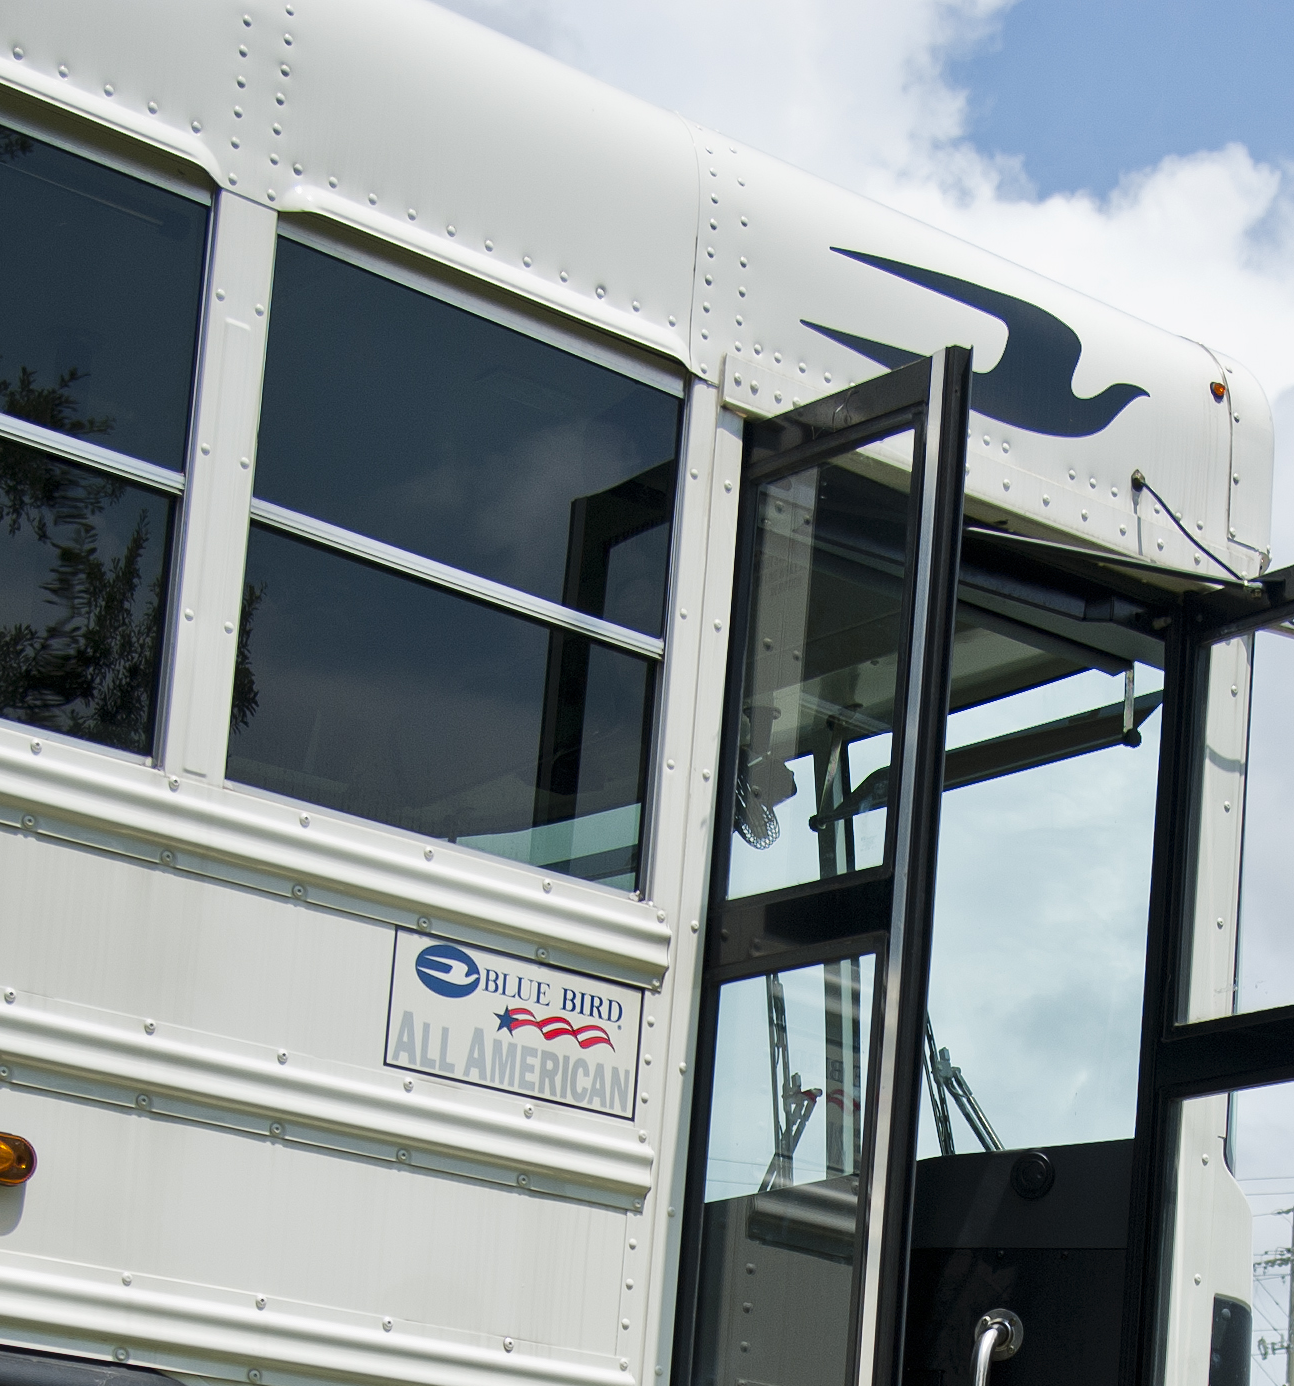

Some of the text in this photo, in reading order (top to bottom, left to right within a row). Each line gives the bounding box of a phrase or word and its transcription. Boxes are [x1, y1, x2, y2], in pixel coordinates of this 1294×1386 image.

[481, 967, 624, 1025] BLUE BIRD
[391, 1010, 631, 1113] ALL AMERICAN
